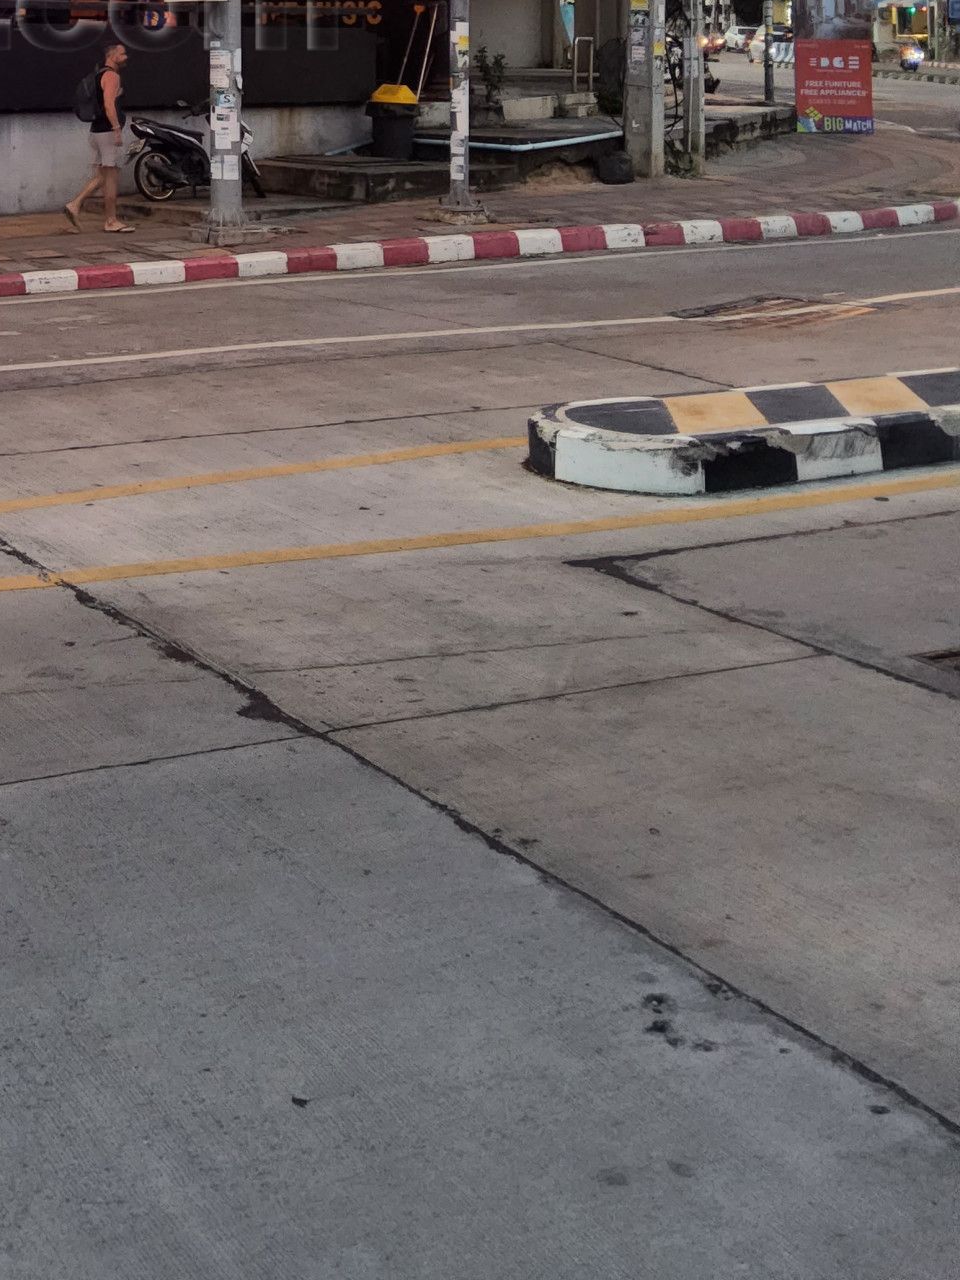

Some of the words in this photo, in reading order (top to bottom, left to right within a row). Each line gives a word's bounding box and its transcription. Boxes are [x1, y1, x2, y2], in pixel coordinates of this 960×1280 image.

[809, 56, 860, 69] EDGE
[801, 88, 819, 96] FREE
[824, 117, 844, 131] BIG
[845, 120, 872, 132] MATCH
